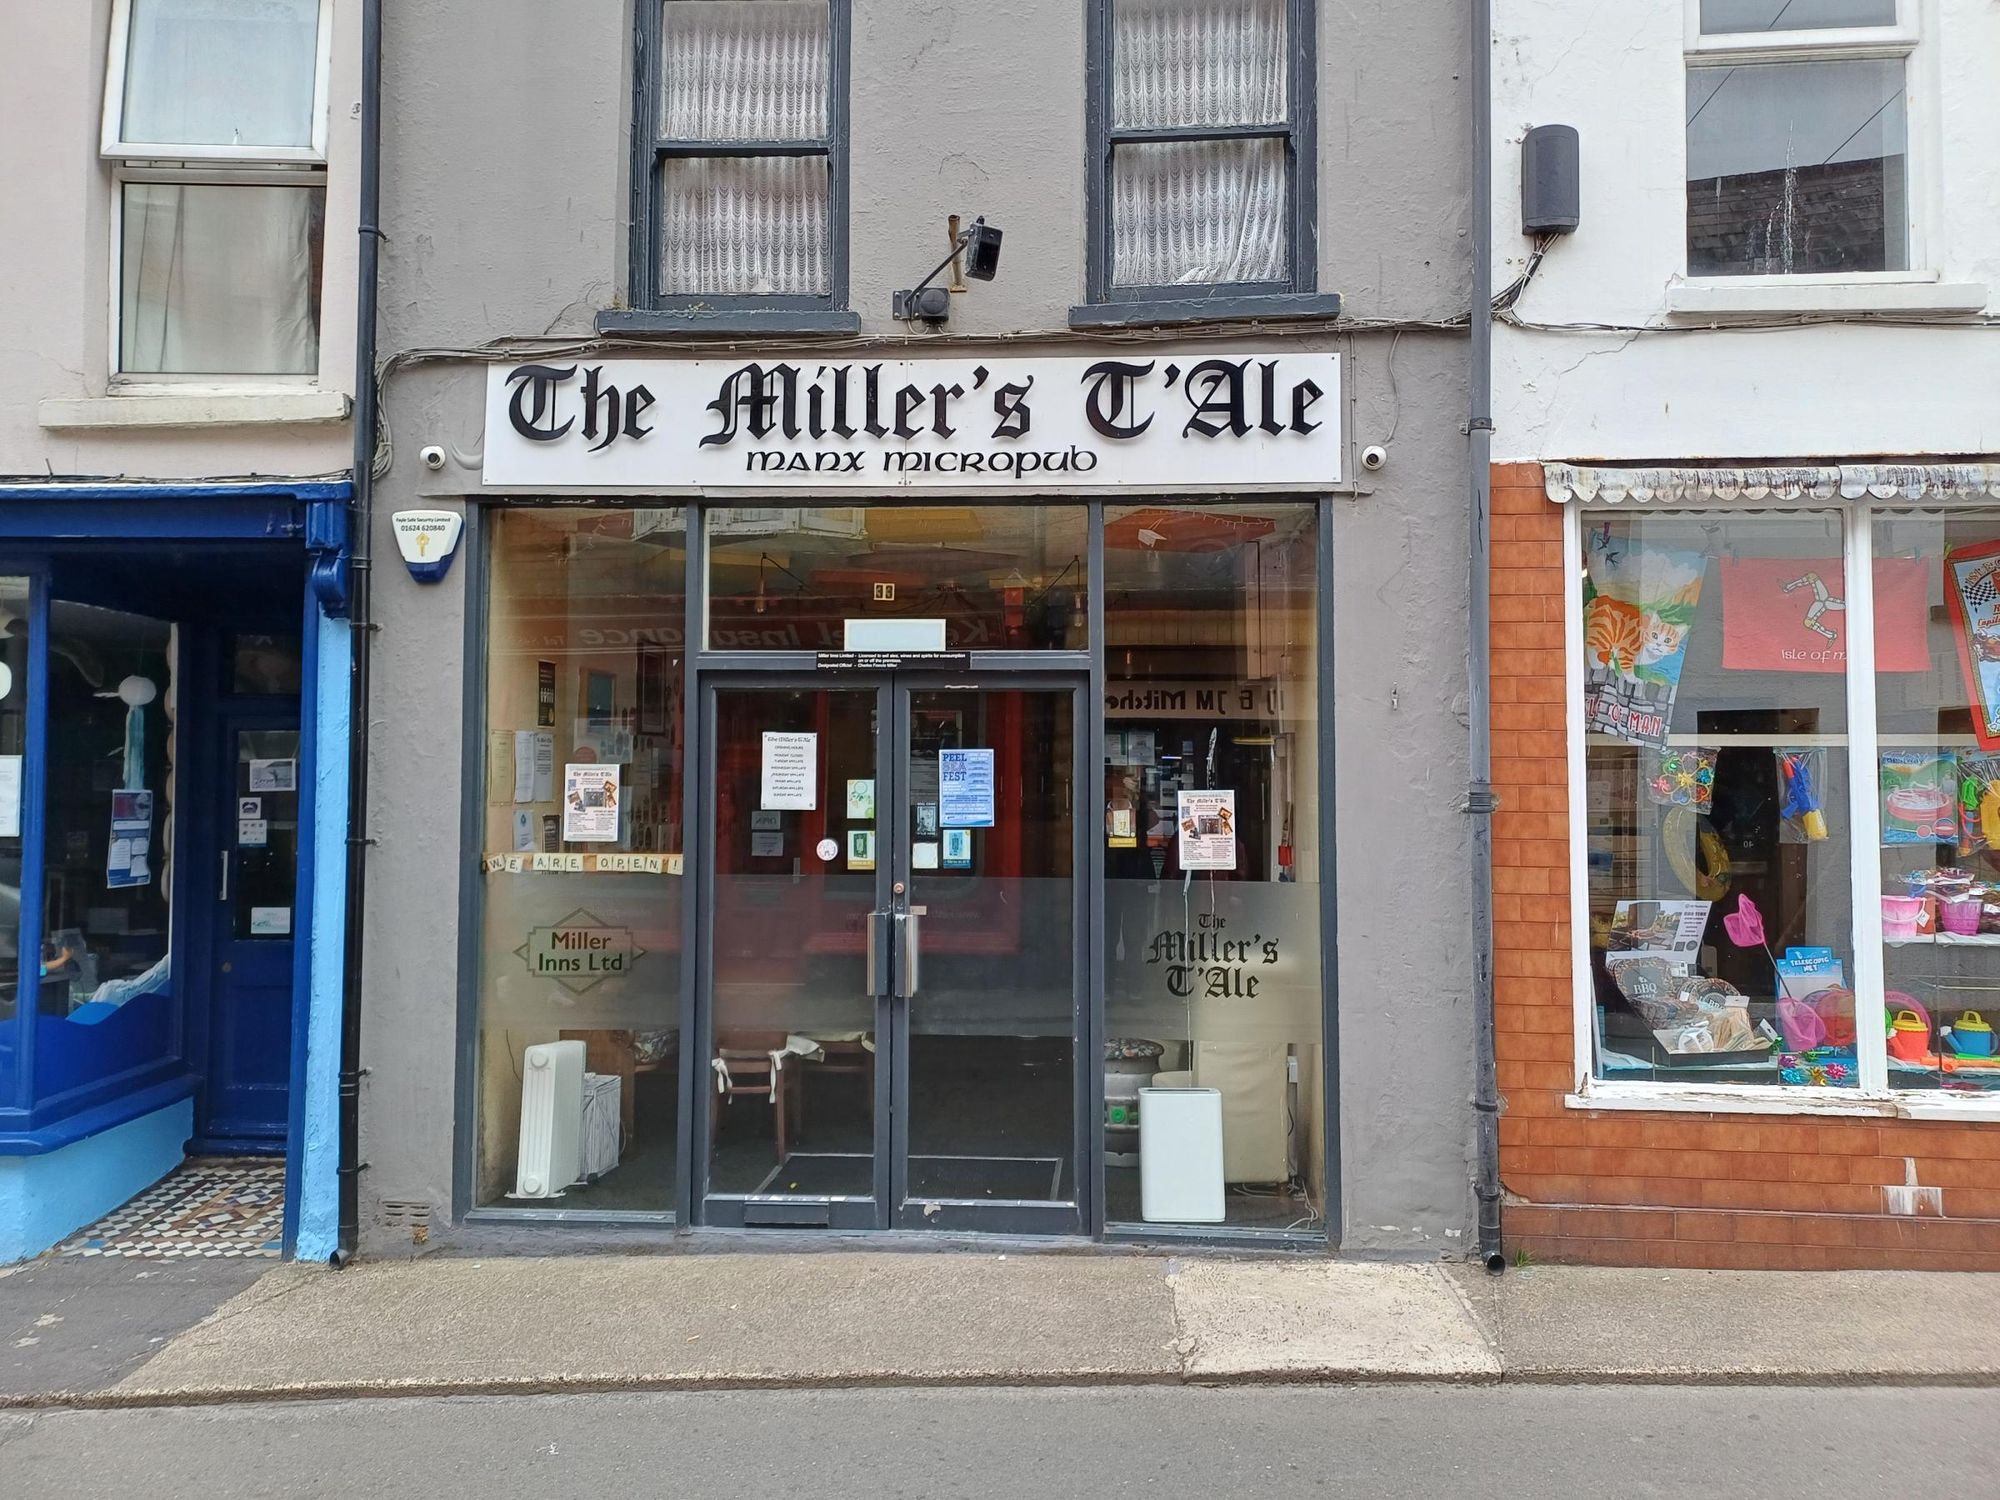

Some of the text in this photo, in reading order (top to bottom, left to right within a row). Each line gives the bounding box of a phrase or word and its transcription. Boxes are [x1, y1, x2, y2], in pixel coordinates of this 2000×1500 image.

[506, 358, 1324, 452] The Miller's T'Ale
[1629, 712, 1662, 736] MAN
[943, 772, 967, 781] FEST
[490, 858, 517, 870] WE
[538, 858, 579, 869] ARE
[1198, 914, 1226, 930] The
[552, 932, 611, 950] Miller
[1146, 931, 1280, 964] Miller's
[539, 953, 622, 971] Inns Ltd
[1790, 956, 1829, 966] TELESCOPIC
[1166, 965, 1259, 998] T'Ale
[1634, 983, 1658, 994] BBQ
